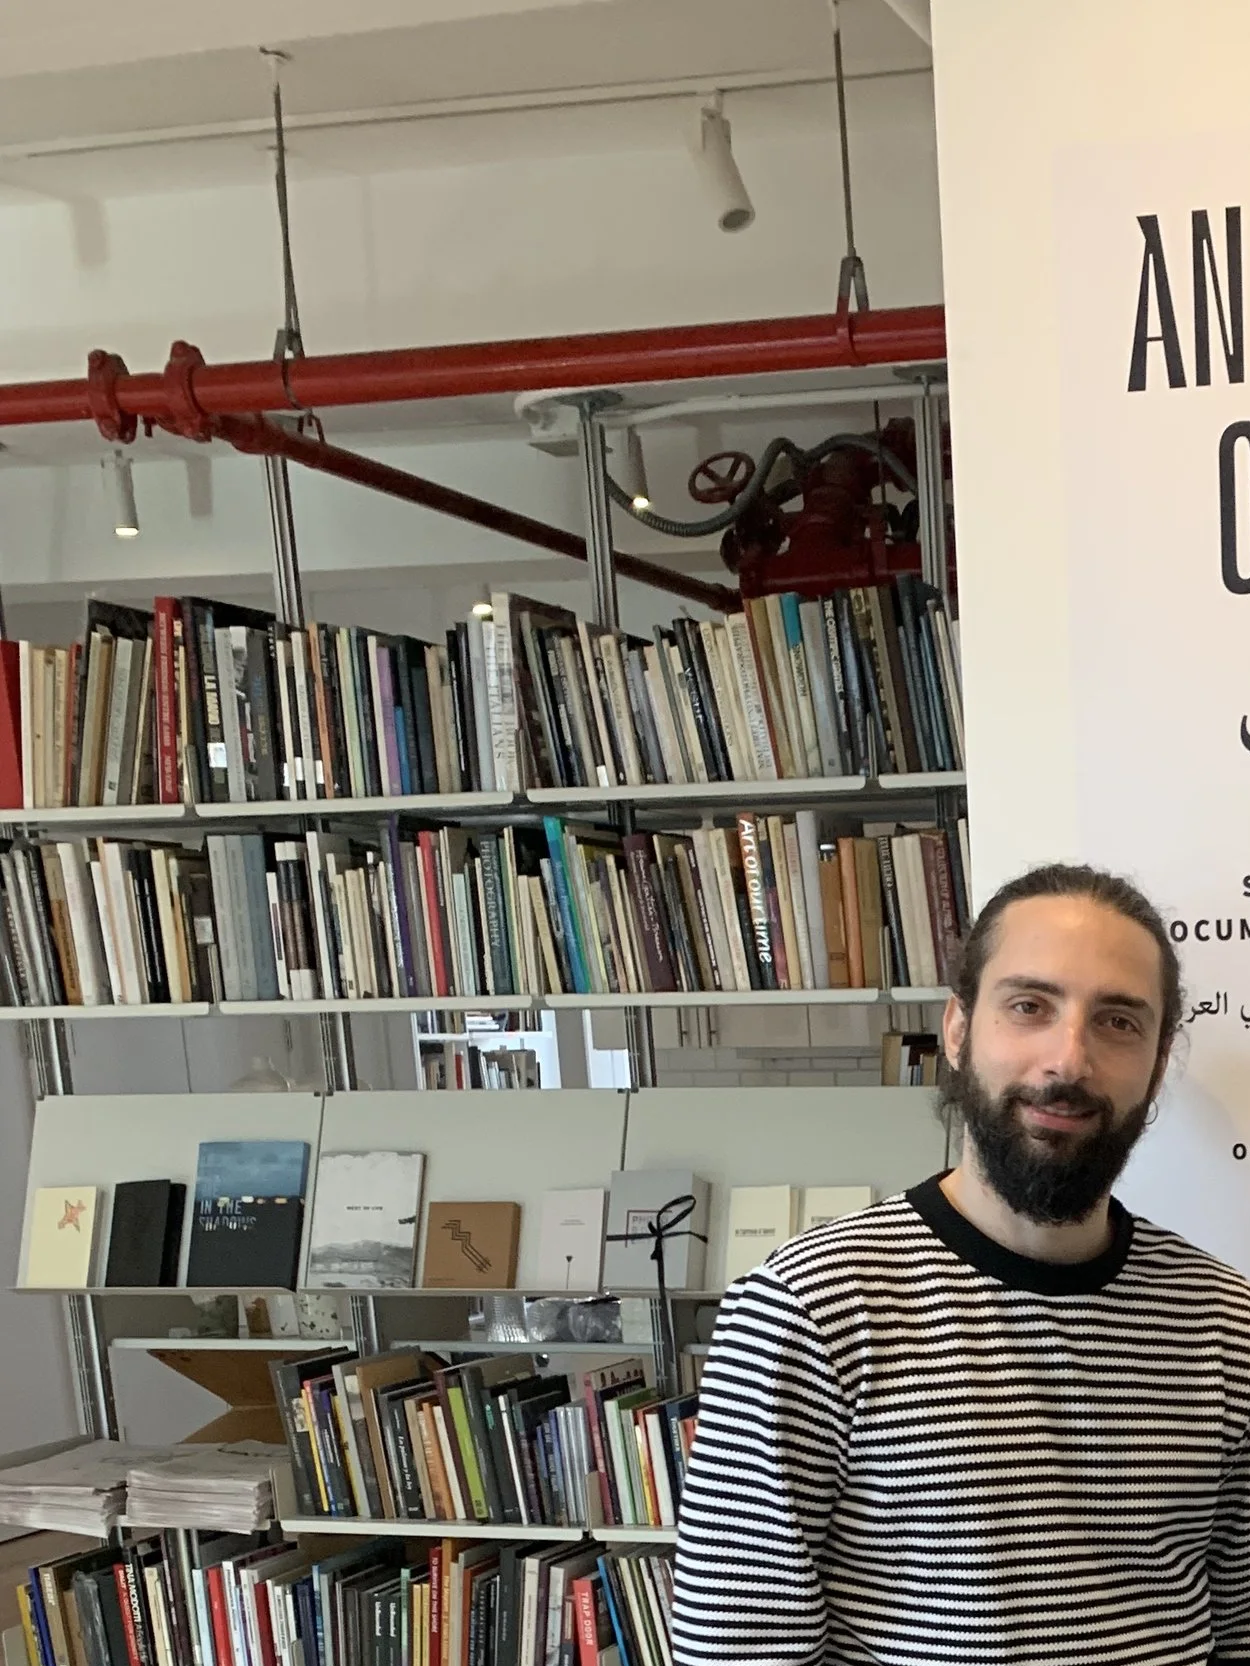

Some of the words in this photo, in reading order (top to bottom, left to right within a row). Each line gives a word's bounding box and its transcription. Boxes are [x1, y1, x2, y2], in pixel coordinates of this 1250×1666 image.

[1128, 206, 1244, 392] AN
[739, 819, 756, 855] Art
[744, 857, 758, 877] of
[480, 841, 500, 948] PHOTOGRAPHY
[747, 879, 762, 915] our
[753, 917, 772, 963] time
[1185, 992, 1227, 1023] العر
[200, 1200, 212, 1214] IN
[125, 1563, 133, 1583] TINA
[128, 1585, 141, 1623] MODOTTI
[582, 1592, 590, 1617] TRAP
